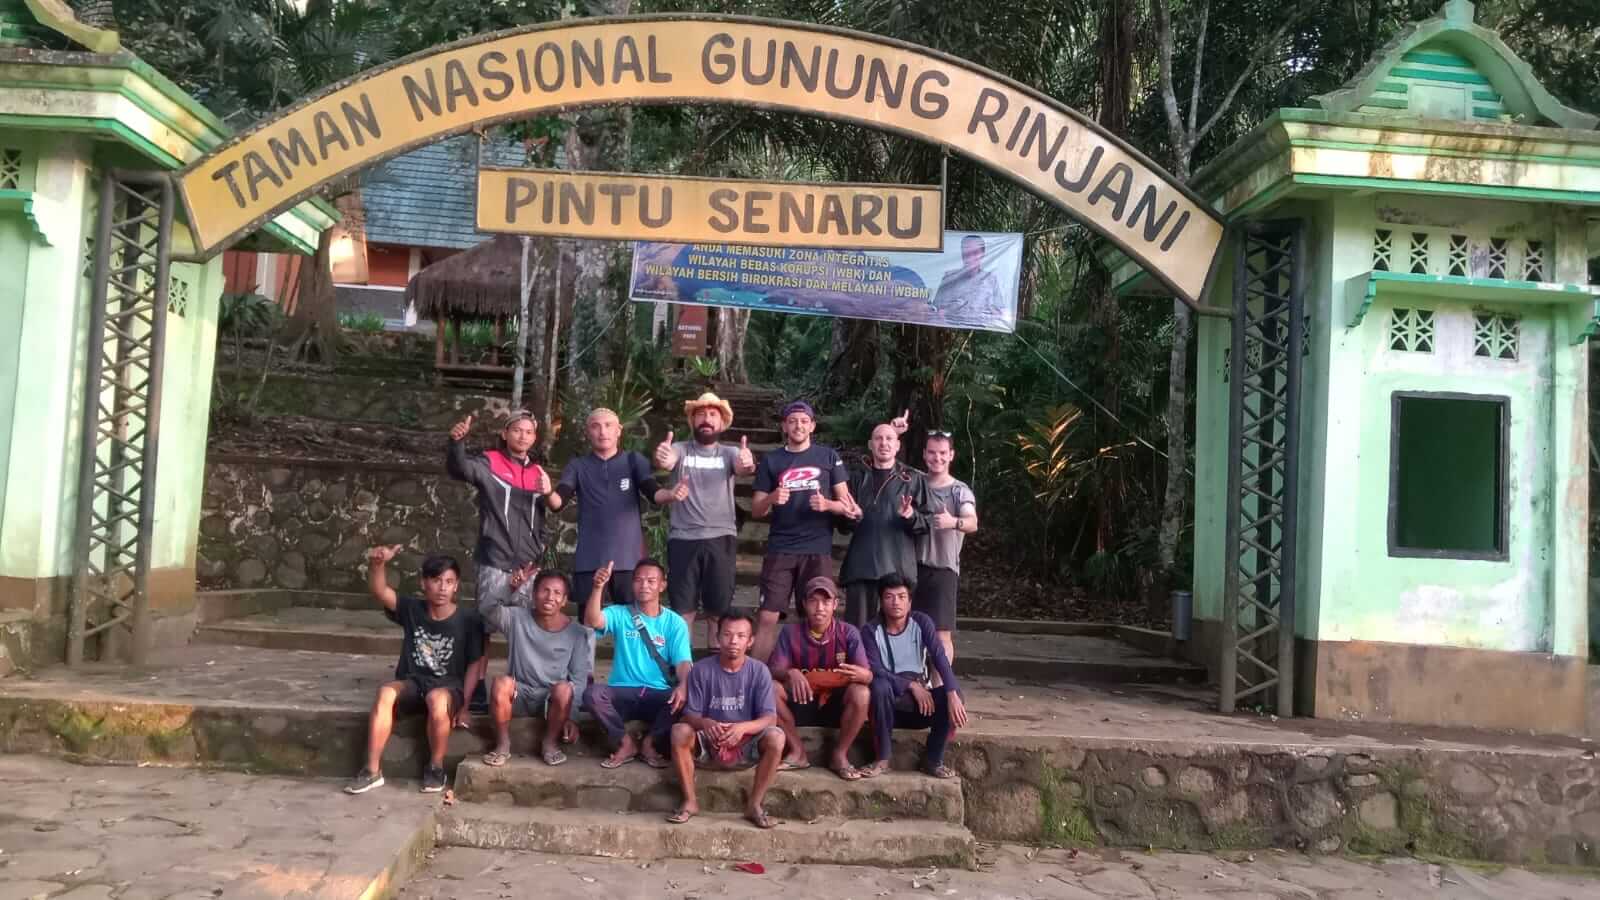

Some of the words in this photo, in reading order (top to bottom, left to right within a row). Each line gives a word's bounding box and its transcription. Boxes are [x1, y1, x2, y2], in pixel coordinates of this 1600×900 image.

[211, 93, 382, 208] TAMAN
[401, 34, 673, 122] NASIONAL
[701, 33, 950, 120] GUNUNG
[967, 88, 1192, 252] RINJANI
[505, 176, 673, 228] PINTU
[707, 188, 923, 240] SENARU
[688, 254, 737, 269] WILAYAH
[740, 259, 776, 273] BEBAS
[781, 263, 829, 277] KORUPSI
[832, 267, 865, 281] (WBK)
[869, 271, 892, 282] DAN
[692, 243, 723, 254] ANDA
[726, 245, 786, 259] MEMASUKI
[789, 250, 819, 261] ZONA
[823, 252, 889, 268] INTEGRITAS
[645, 265, 694, 279] WILAYAH
[698, 269, 738, 283] BERSIH
[742, 274, 802, 289] BIROKRASI
[806, 279, 828, 290] DAN
[831, 282, 887, 296] MELAYANI
